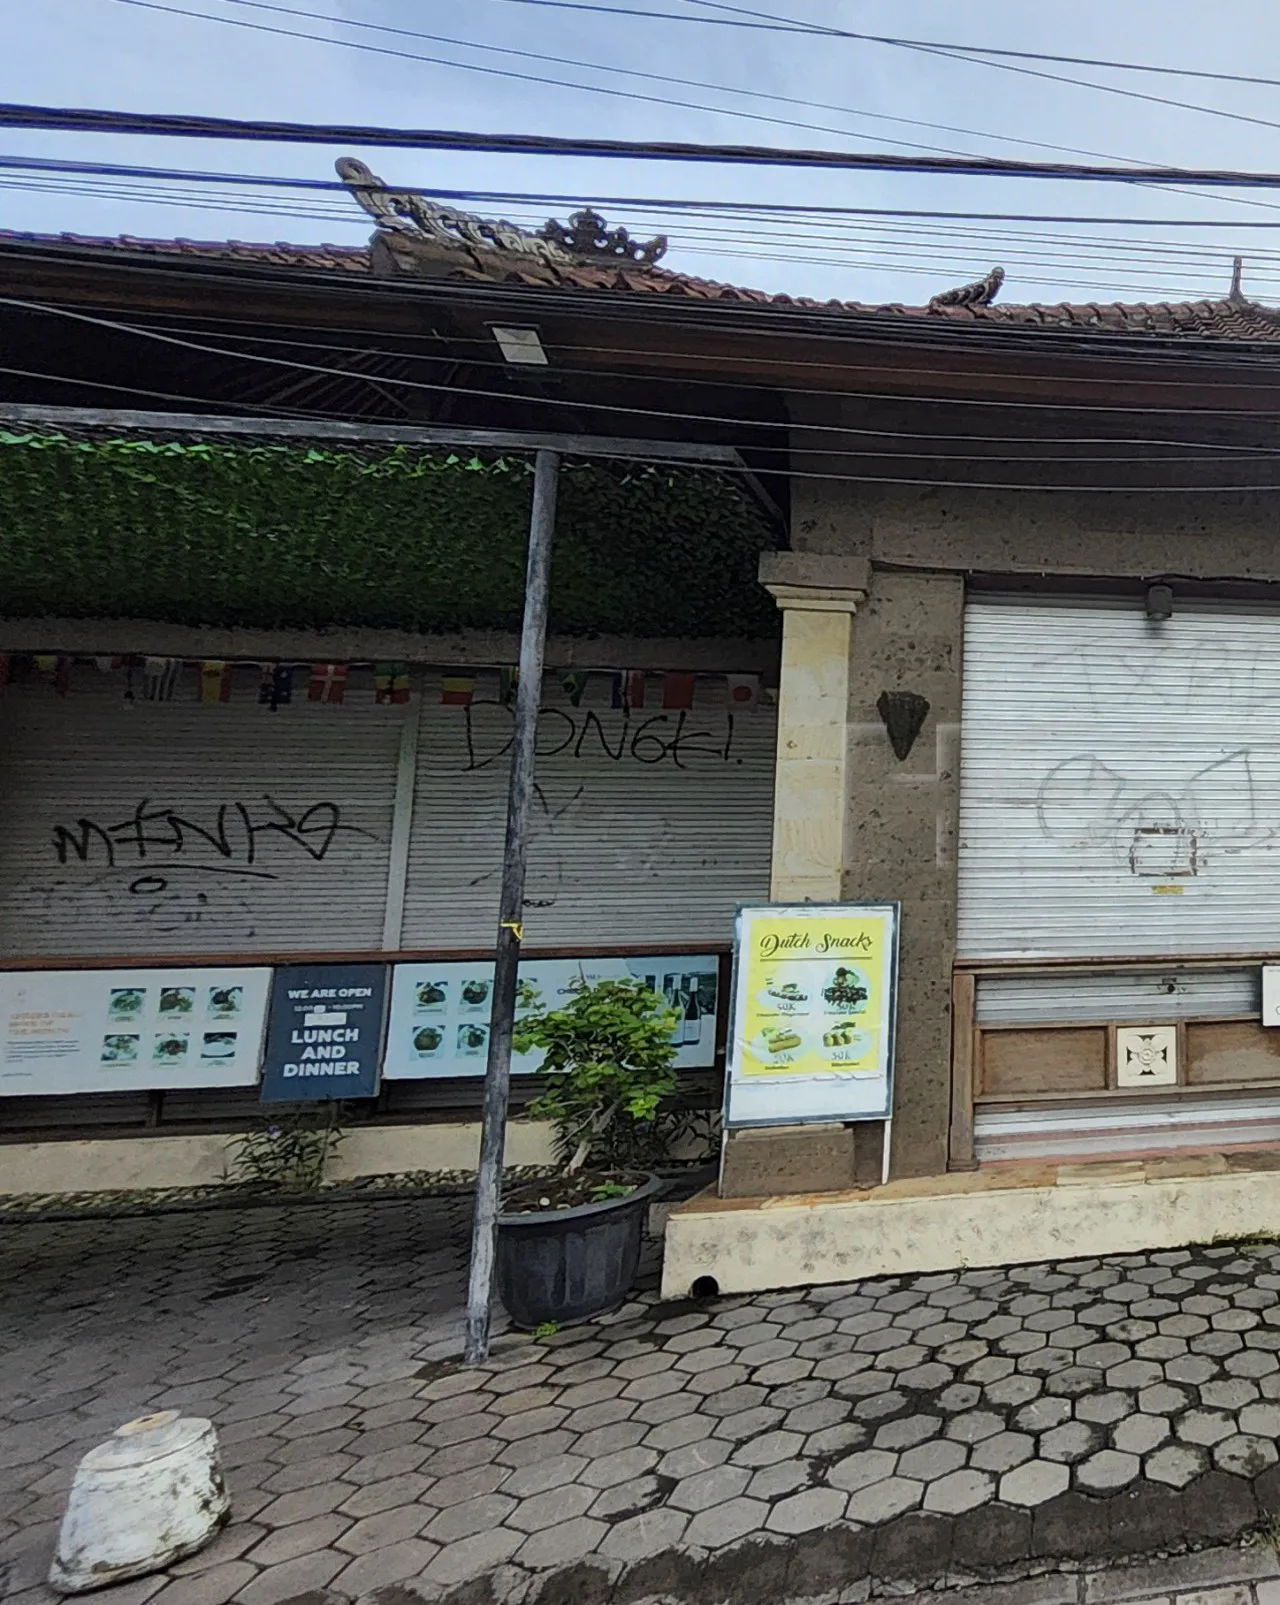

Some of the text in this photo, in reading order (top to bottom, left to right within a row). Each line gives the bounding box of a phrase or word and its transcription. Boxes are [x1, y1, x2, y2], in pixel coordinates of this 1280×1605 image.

[759, 931, 874, 957] Dutch Snacks
[287, 987, 373, 999] WE ARE OPEN
[291, 1028, 359, 1044] LUNCH
[300, 1045, 346, 1060] AND
[283, 1061, 360, 1077] DINNER
